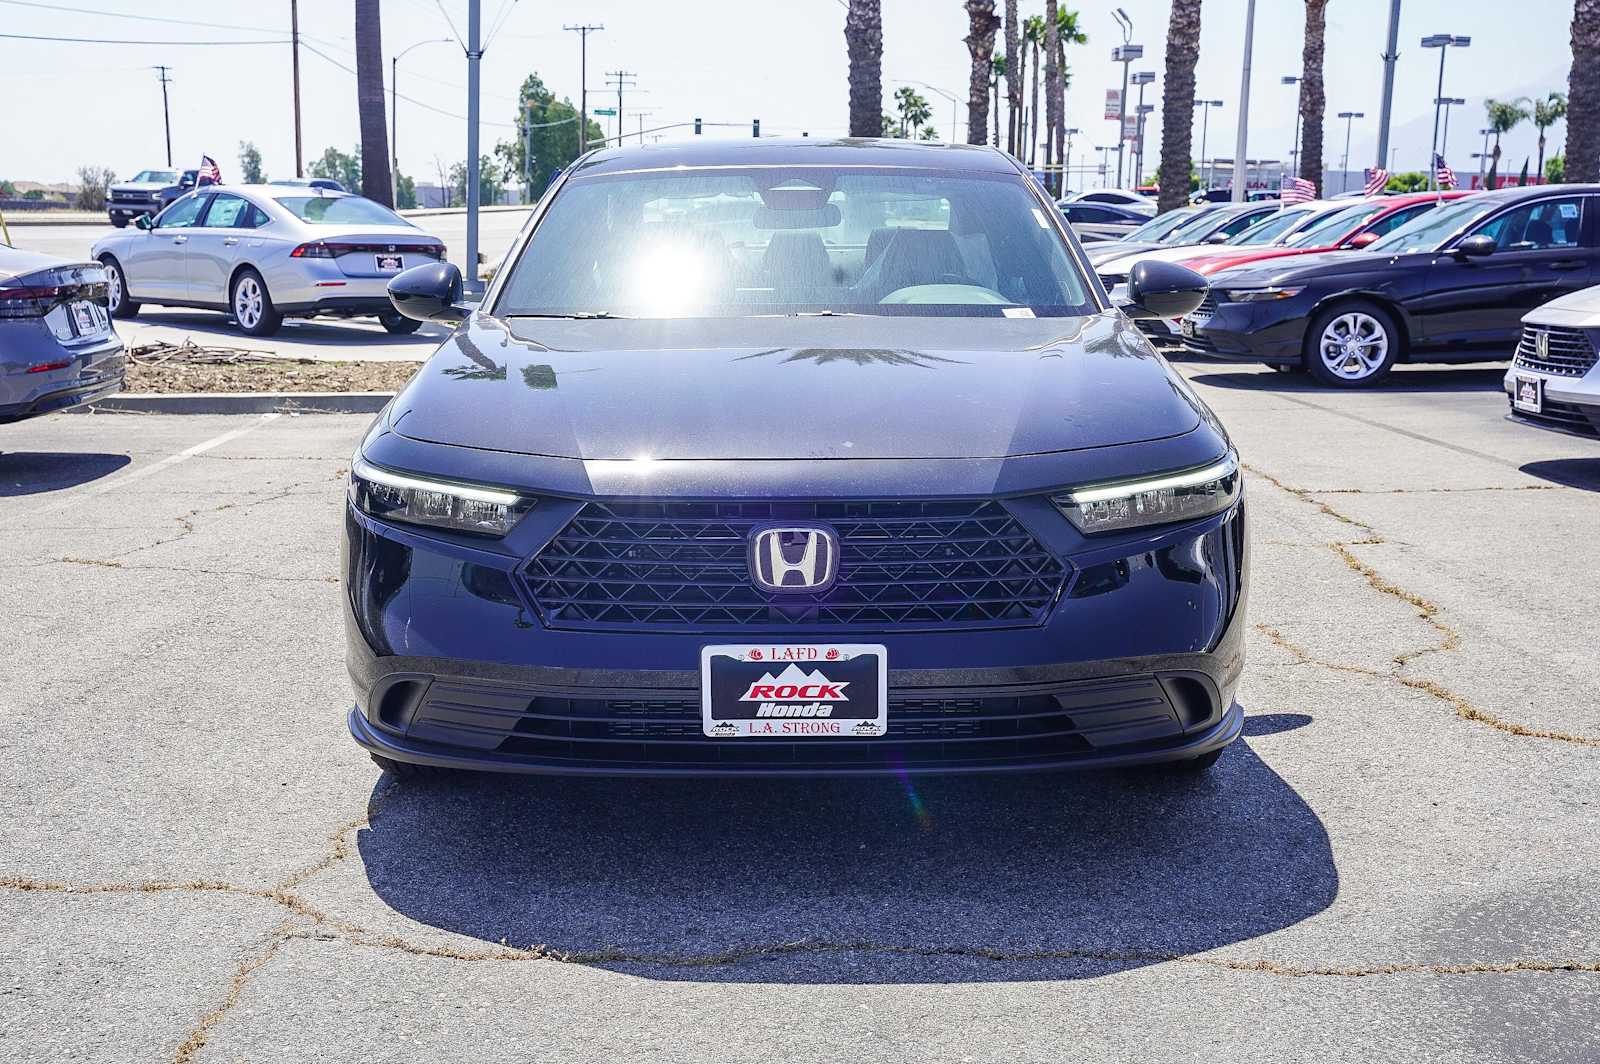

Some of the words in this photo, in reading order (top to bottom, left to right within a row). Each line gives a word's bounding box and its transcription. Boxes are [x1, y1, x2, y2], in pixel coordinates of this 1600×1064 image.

[771, 647, 817, 660] LAFD
[750, 685, 842, 698] ROCK
[756, 702, 834, 717] Honda
[749, 722, 777, 734] L.A.
[780, 722, 841, 734] STRONG
